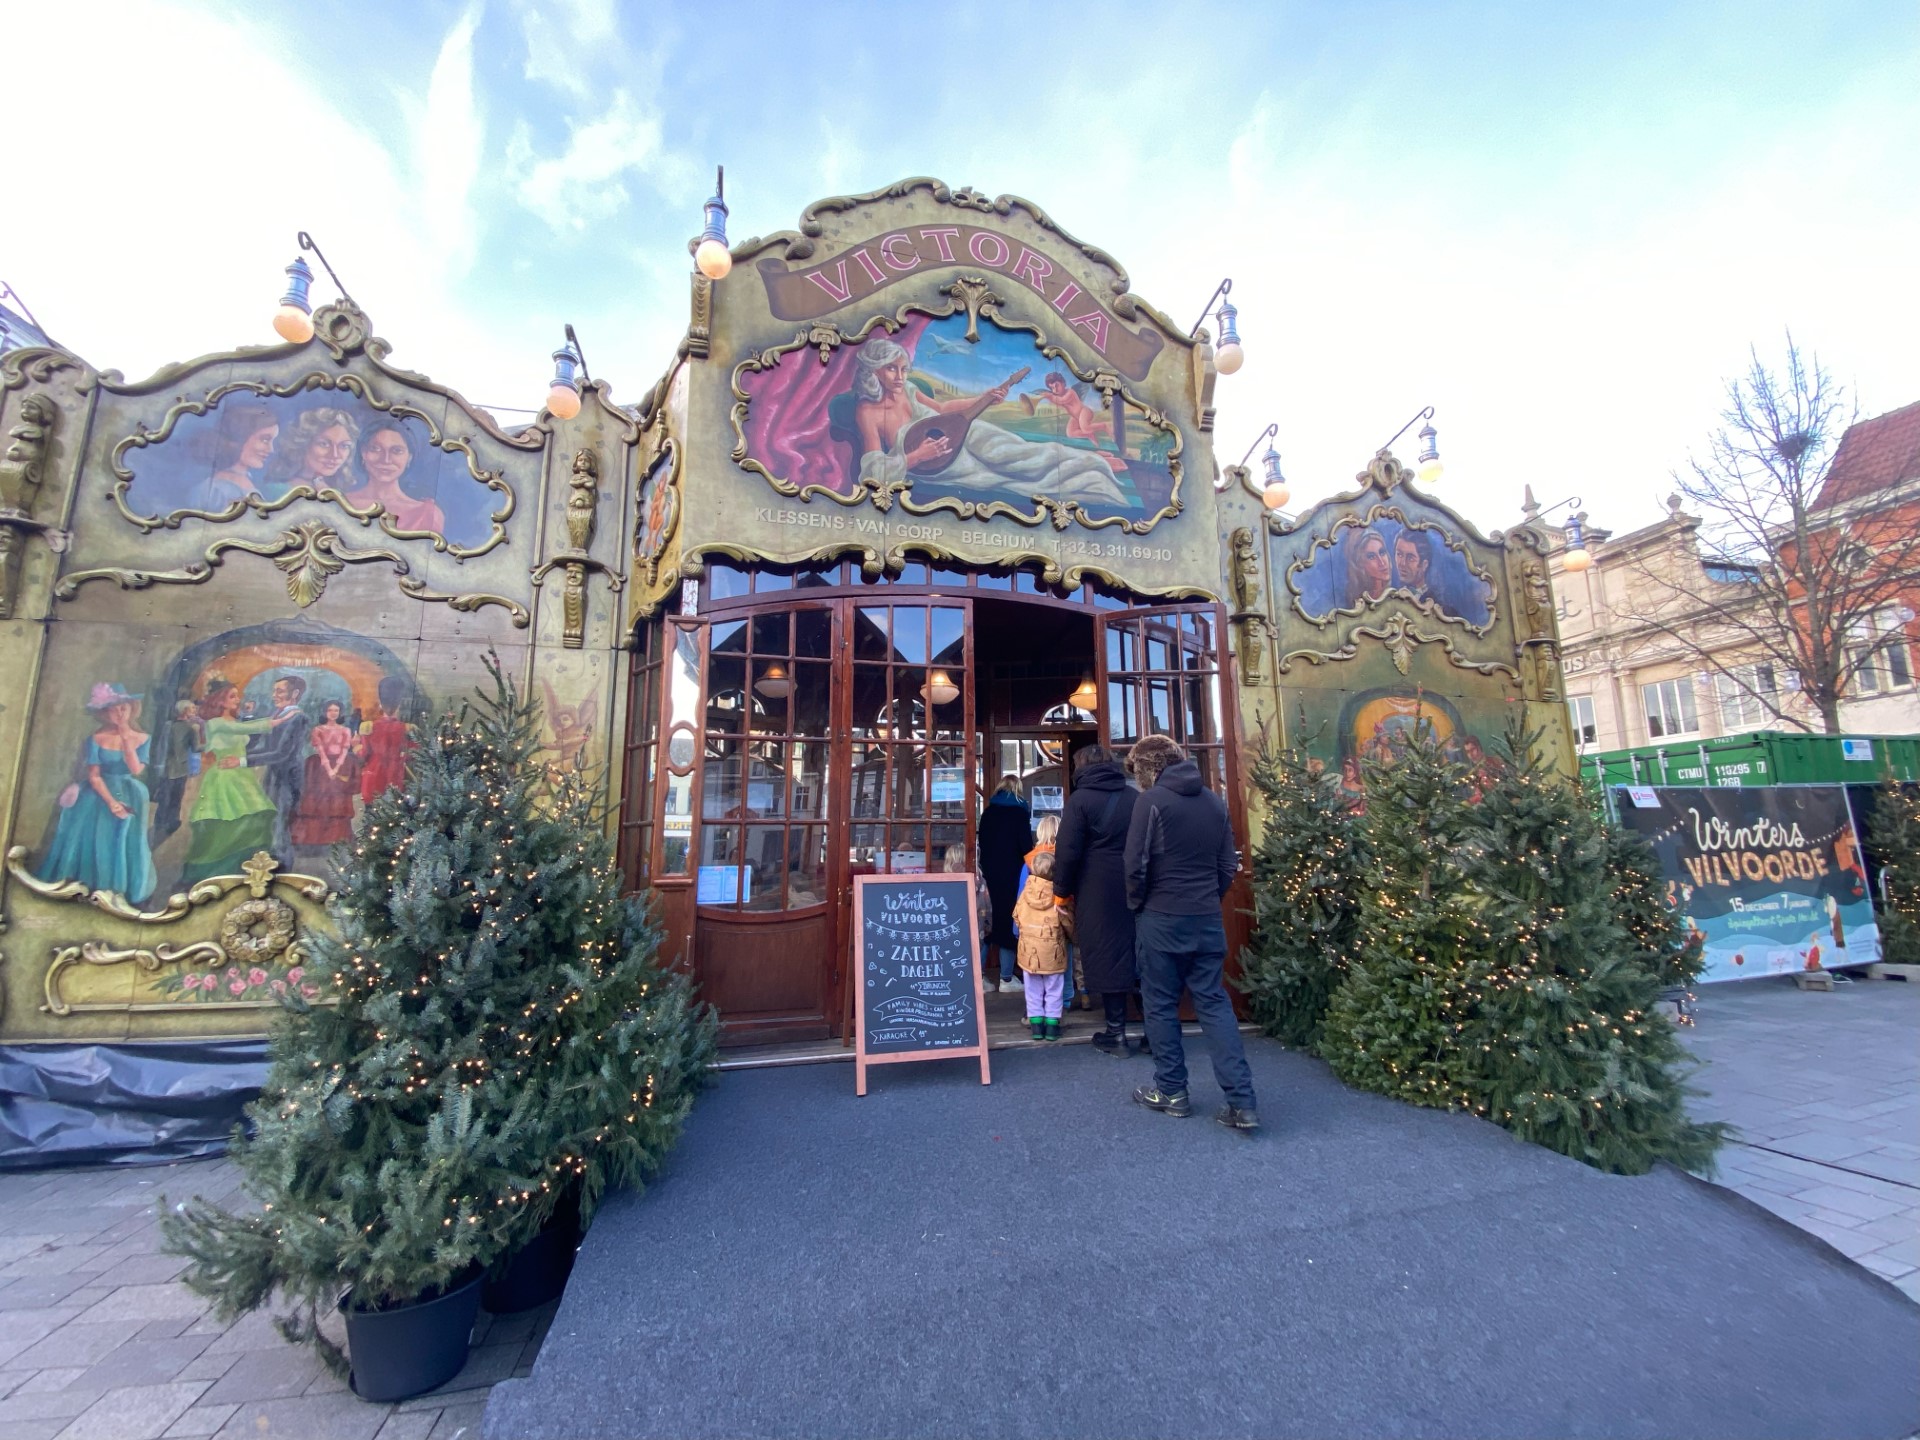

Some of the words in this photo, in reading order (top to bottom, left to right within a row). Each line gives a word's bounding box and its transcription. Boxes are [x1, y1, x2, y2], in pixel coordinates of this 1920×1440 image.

[804, 227, 1114, 354] VICTORIA
[755, 507, 845, 530] KLESSENS
[856, 518, 891, 536] VAN
[896, 524, 943, 541] GORP
[961, 530, 1036, 550] BELGIUM
[1677, 767, 1703, 780] CTMU
[1714, 763, 1750, 777] 110295
[1688, 807, 1805, 851] Winters
[1684, 847, 1830, 888] VILVOORDE
[883, 889, 949, 912] Winters
[1729, 897, 1745, 913] 15
[1780, 893, 1789, 909] 7
[880, 911, 948, 926] VILVOORDE
[900, 963, 944, 978] DAGEN
[887, 1000, 911, 1011] FAMILY
